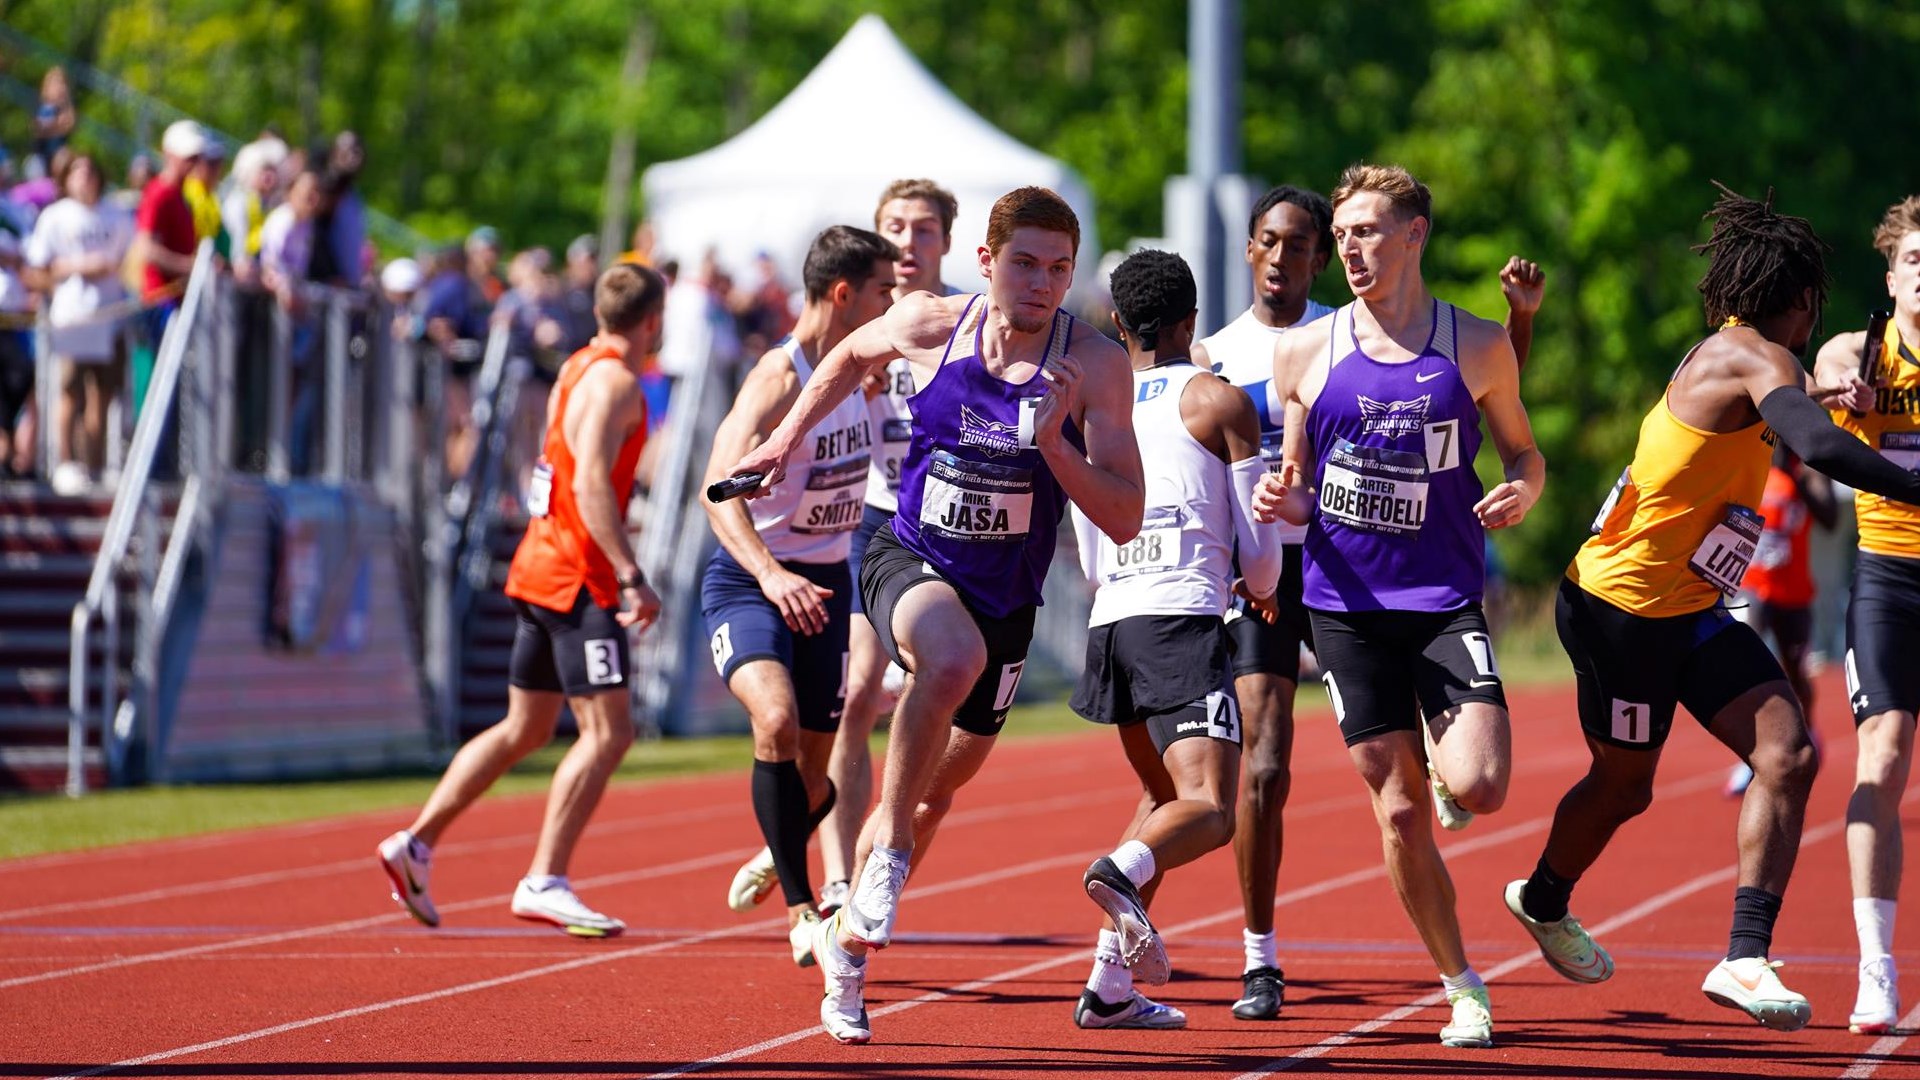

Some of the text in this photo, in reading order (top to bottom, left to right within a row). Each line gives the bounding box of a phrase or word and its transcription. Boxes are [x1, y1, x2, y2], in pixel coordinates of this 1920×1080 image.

[815, 421, 872, 460] BETHEL
[1365, 419, 1421, 431] DUHAWKS
[963, 433, 1018, 454] DUHAWKS
[1432, 423, 1452, 469] 7
[965, 475, 981, 483] FIELD
[981, 478, 1031, 488] CHAMPIONSHIPS
[1354, 477, 1395, 495] CARTER
[807, 498, 862, 526] SMITH
[962, 492, 991, 507] MIKE
[1322, 482, 1422, 526] OBERFOELL
[940, 502, 1009, 532] JASA
[1117, 533, 1162, 567] 688
[595, 645, 611, 679] 3
[1472, 635, 1493, 673] 7
[1002, 663, 1024, 707] 7
[1213, 695, 1235, 739] 4
[1621, 706, 1638, 740] 1
